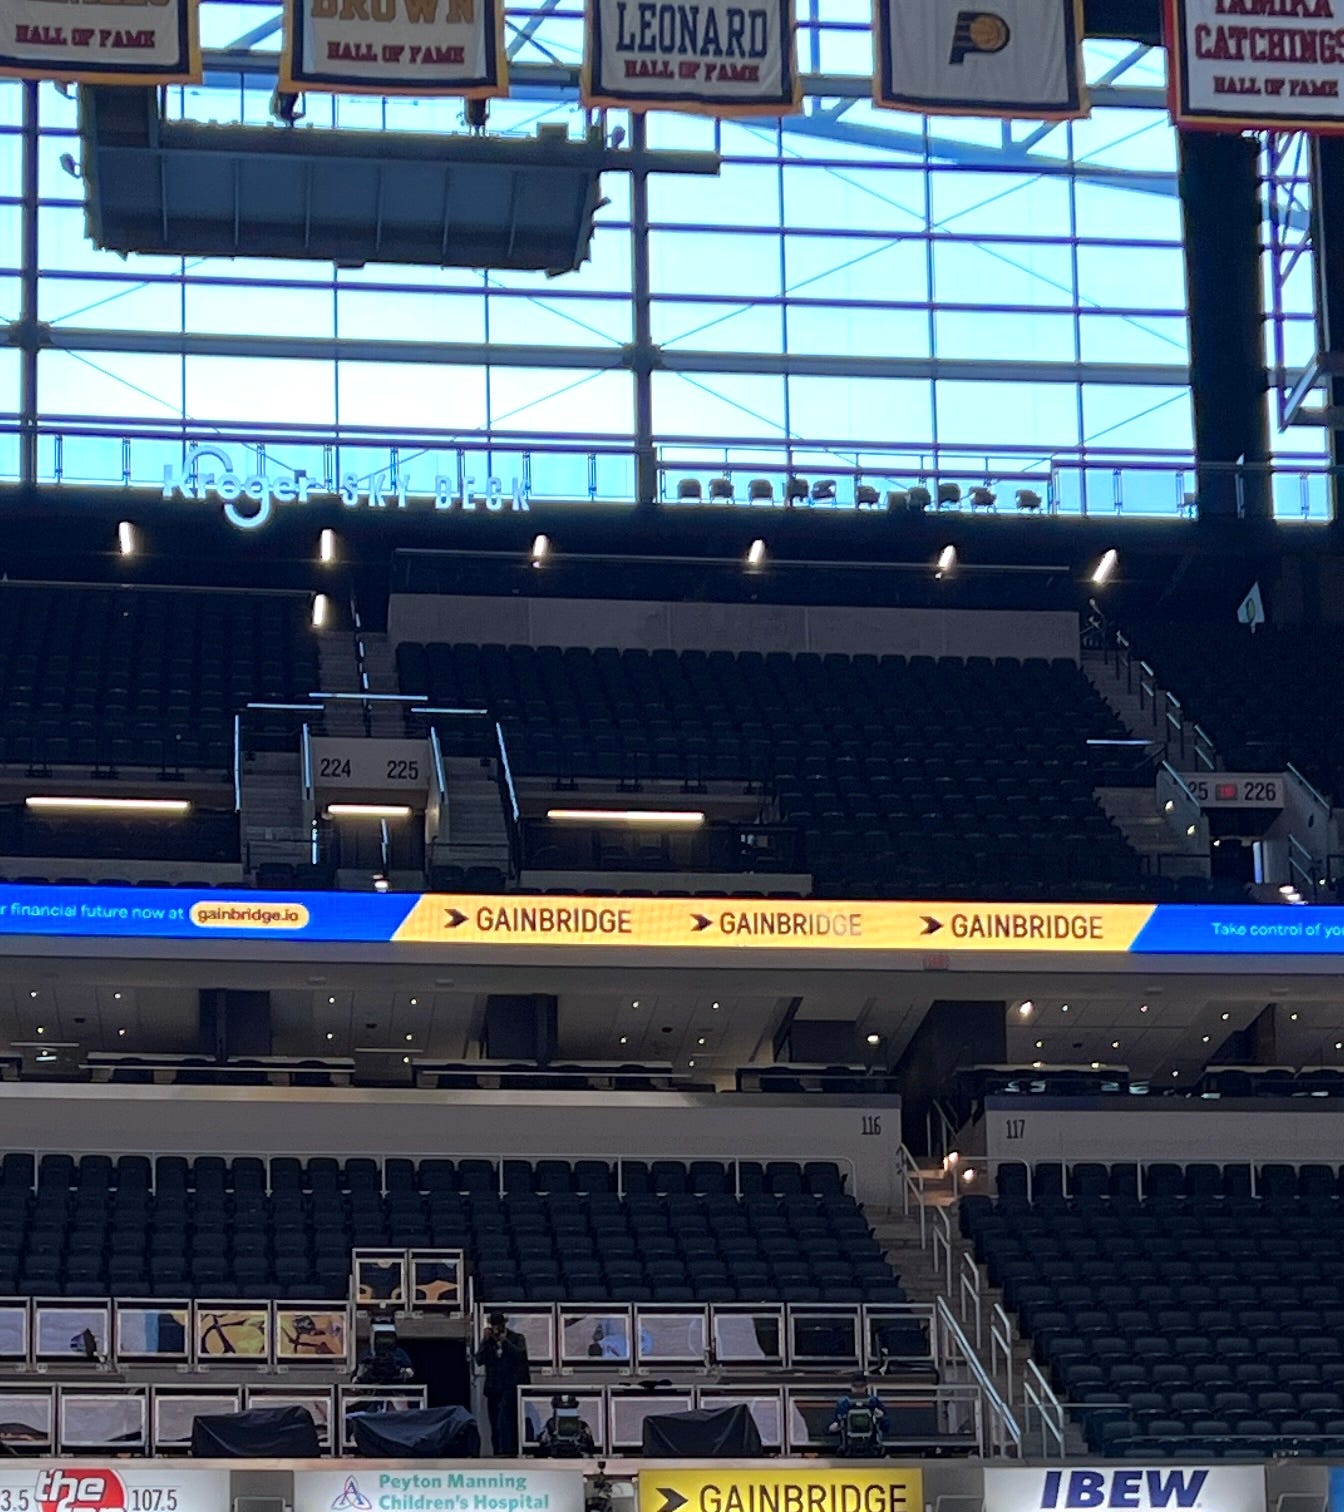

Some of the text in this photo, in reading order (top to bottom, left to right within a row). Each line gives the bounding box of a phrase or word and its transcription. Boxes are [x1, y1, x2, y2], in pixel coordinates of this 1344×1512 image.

[15, 25, 156, 49] HALL OF FAME
[615, 1, 768, 59] LEONARD
[327, 41, 465, 65] HALL OF FAME
[624, 60, 761, 83] HALL OF FAME
[1213, 76, 1339, 98] HALL OF FAME
[162, 445, 530, 528] Kroger SKY DECK
[320, 758, 419, 780] 224 225
[1244, 782, 1277, 801] 226
[10, 900, 77, 917] financial
[80, 902, 128, 919] future
[132, 907, 165, 920] now
[168, 906, 184, 920] at
[197, 906, 300, 924] gainbridge.io
[476, 906, 633, 935] GAINBRIDGE
[719, 911, 863, 938] GAINBRIDGE
[950, 913, 1104, 940] GAINBRIDGE
[1211, 922, 1247, 936] Take
[1250, 922, 1303, 936] control
[1305, 922, 1321, 936] of
[860, 1115, 882, 1136] 116
[1005, 1119, 1026, 1140] 117
[35, 1470, 106, 1503] the
[132, 1488, 177, 1512] 107.5
[379, 1473, 442, 1492] Peyton
[447, 1473, 528, 1492] Manning
[1040, 1470, 1210, 1509] IBEW
[378, 1494, 469, 1511] Children's
